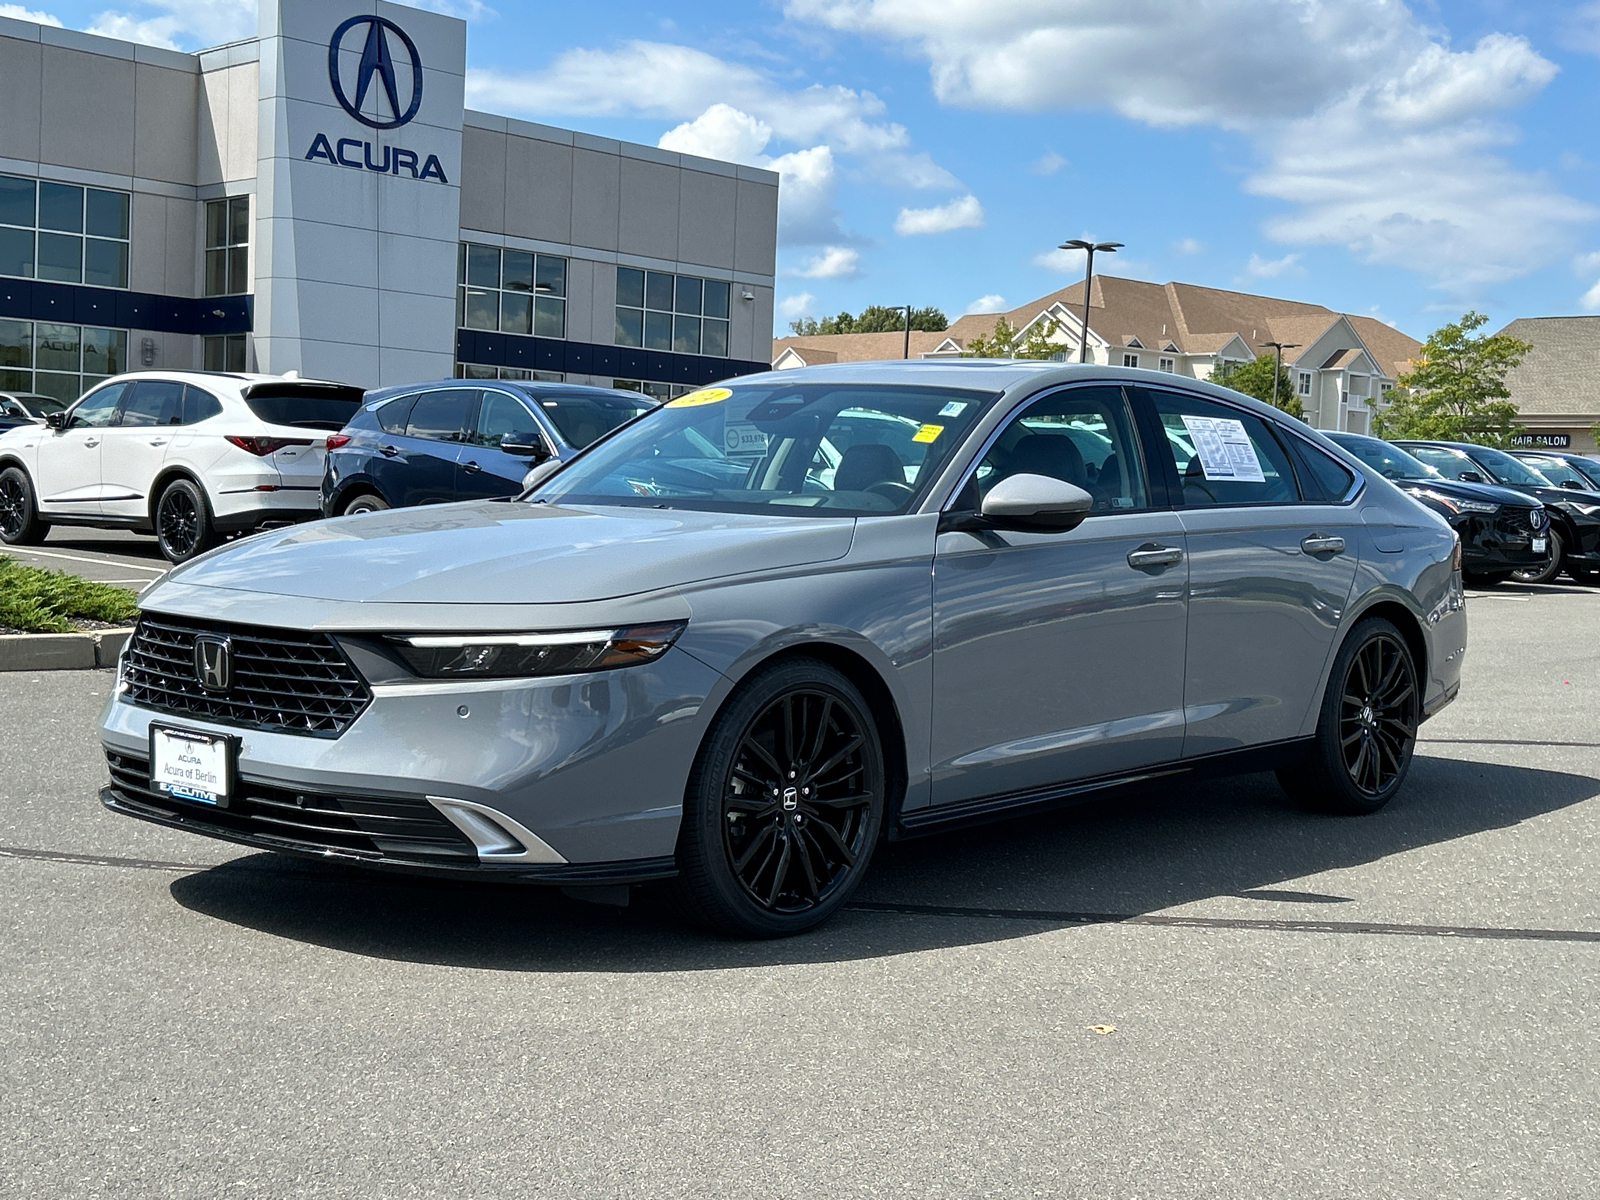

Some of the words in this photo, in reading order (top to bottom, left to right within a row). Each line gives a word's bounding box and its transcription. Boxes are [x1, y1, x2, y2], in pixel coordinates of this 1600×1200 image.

[304, 133, 448, 183] ACURA
[40, 341, 98, 354] ACURA
[1510, 436, 1533, 446] HAIR
[1536, 436, 1567, 446] SALON
[177, 754, 202, 765] ACURA
[164, 762, 184, 777] Acura
[185, 768, 193, 779] of
[195, 769, 218, 784] Berlin
[160, 782, 217, 801] EXECUTIVE
